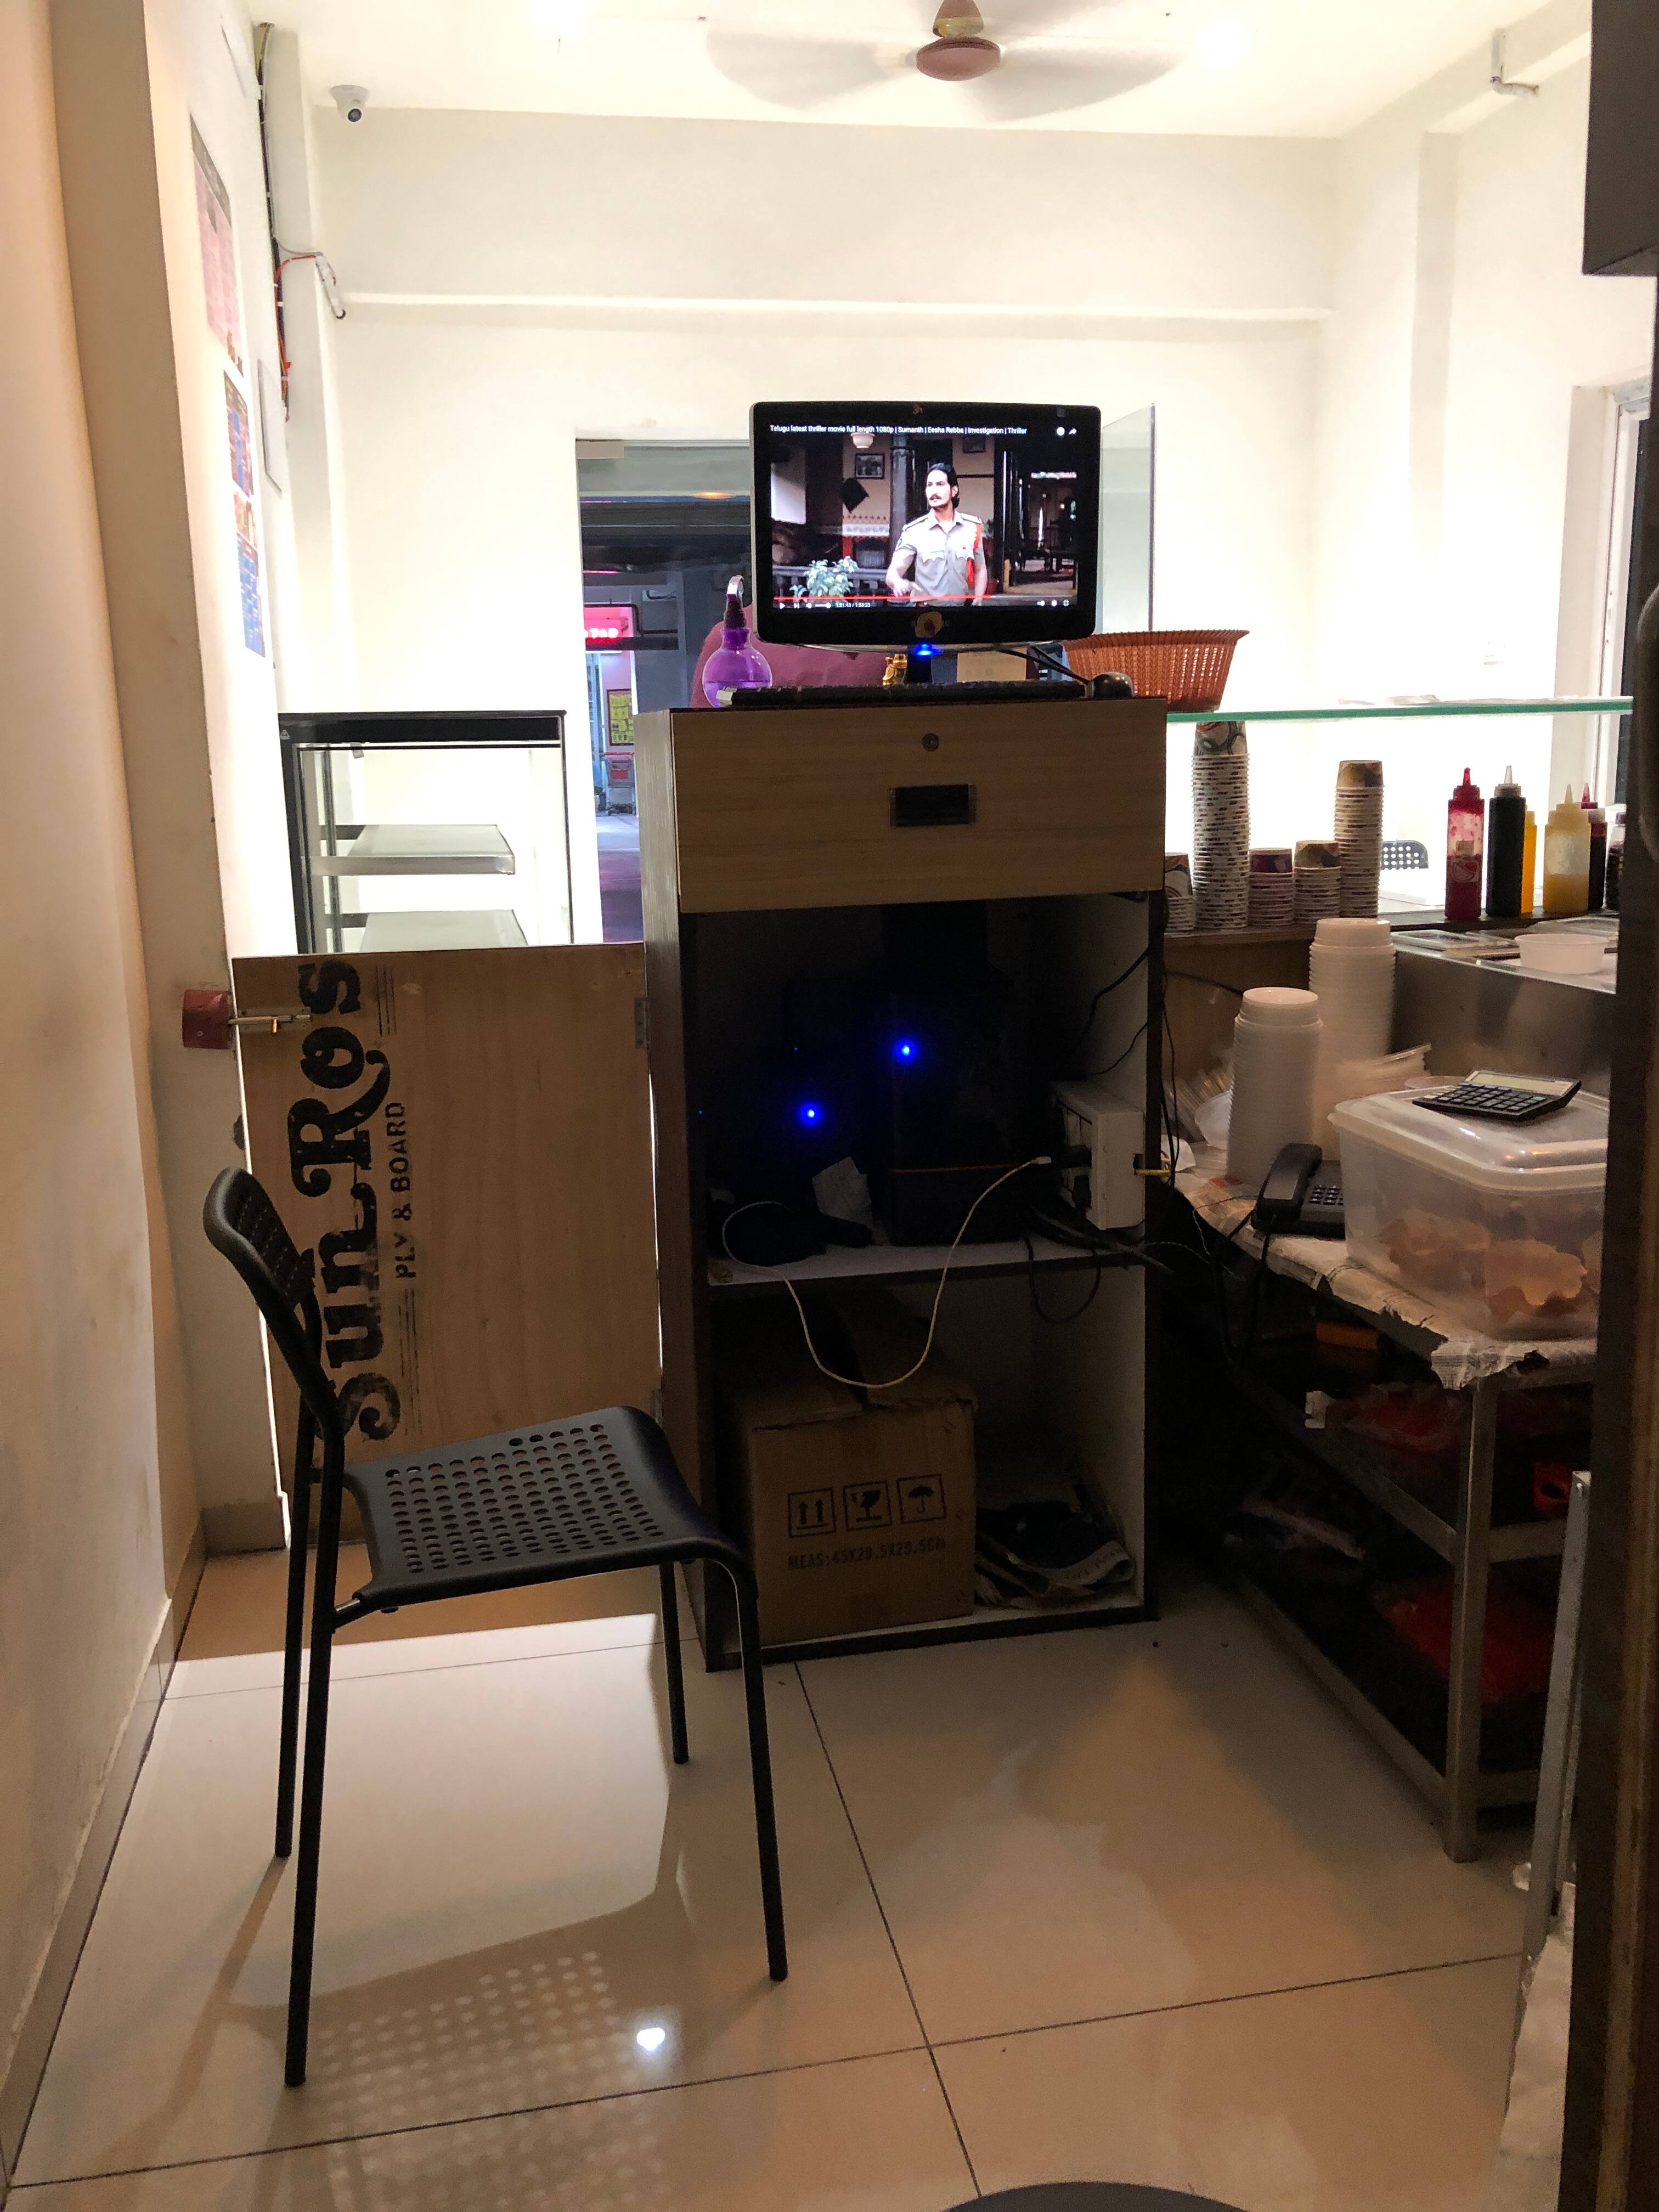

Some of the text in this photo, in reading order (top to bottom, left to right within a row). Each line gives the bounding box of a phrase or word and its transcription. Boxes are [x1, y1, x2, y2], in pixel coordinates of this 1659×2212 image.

[770, 425, 789, 433] Telugu
[385, 1102, 417, 1279] PLY & BOARD
